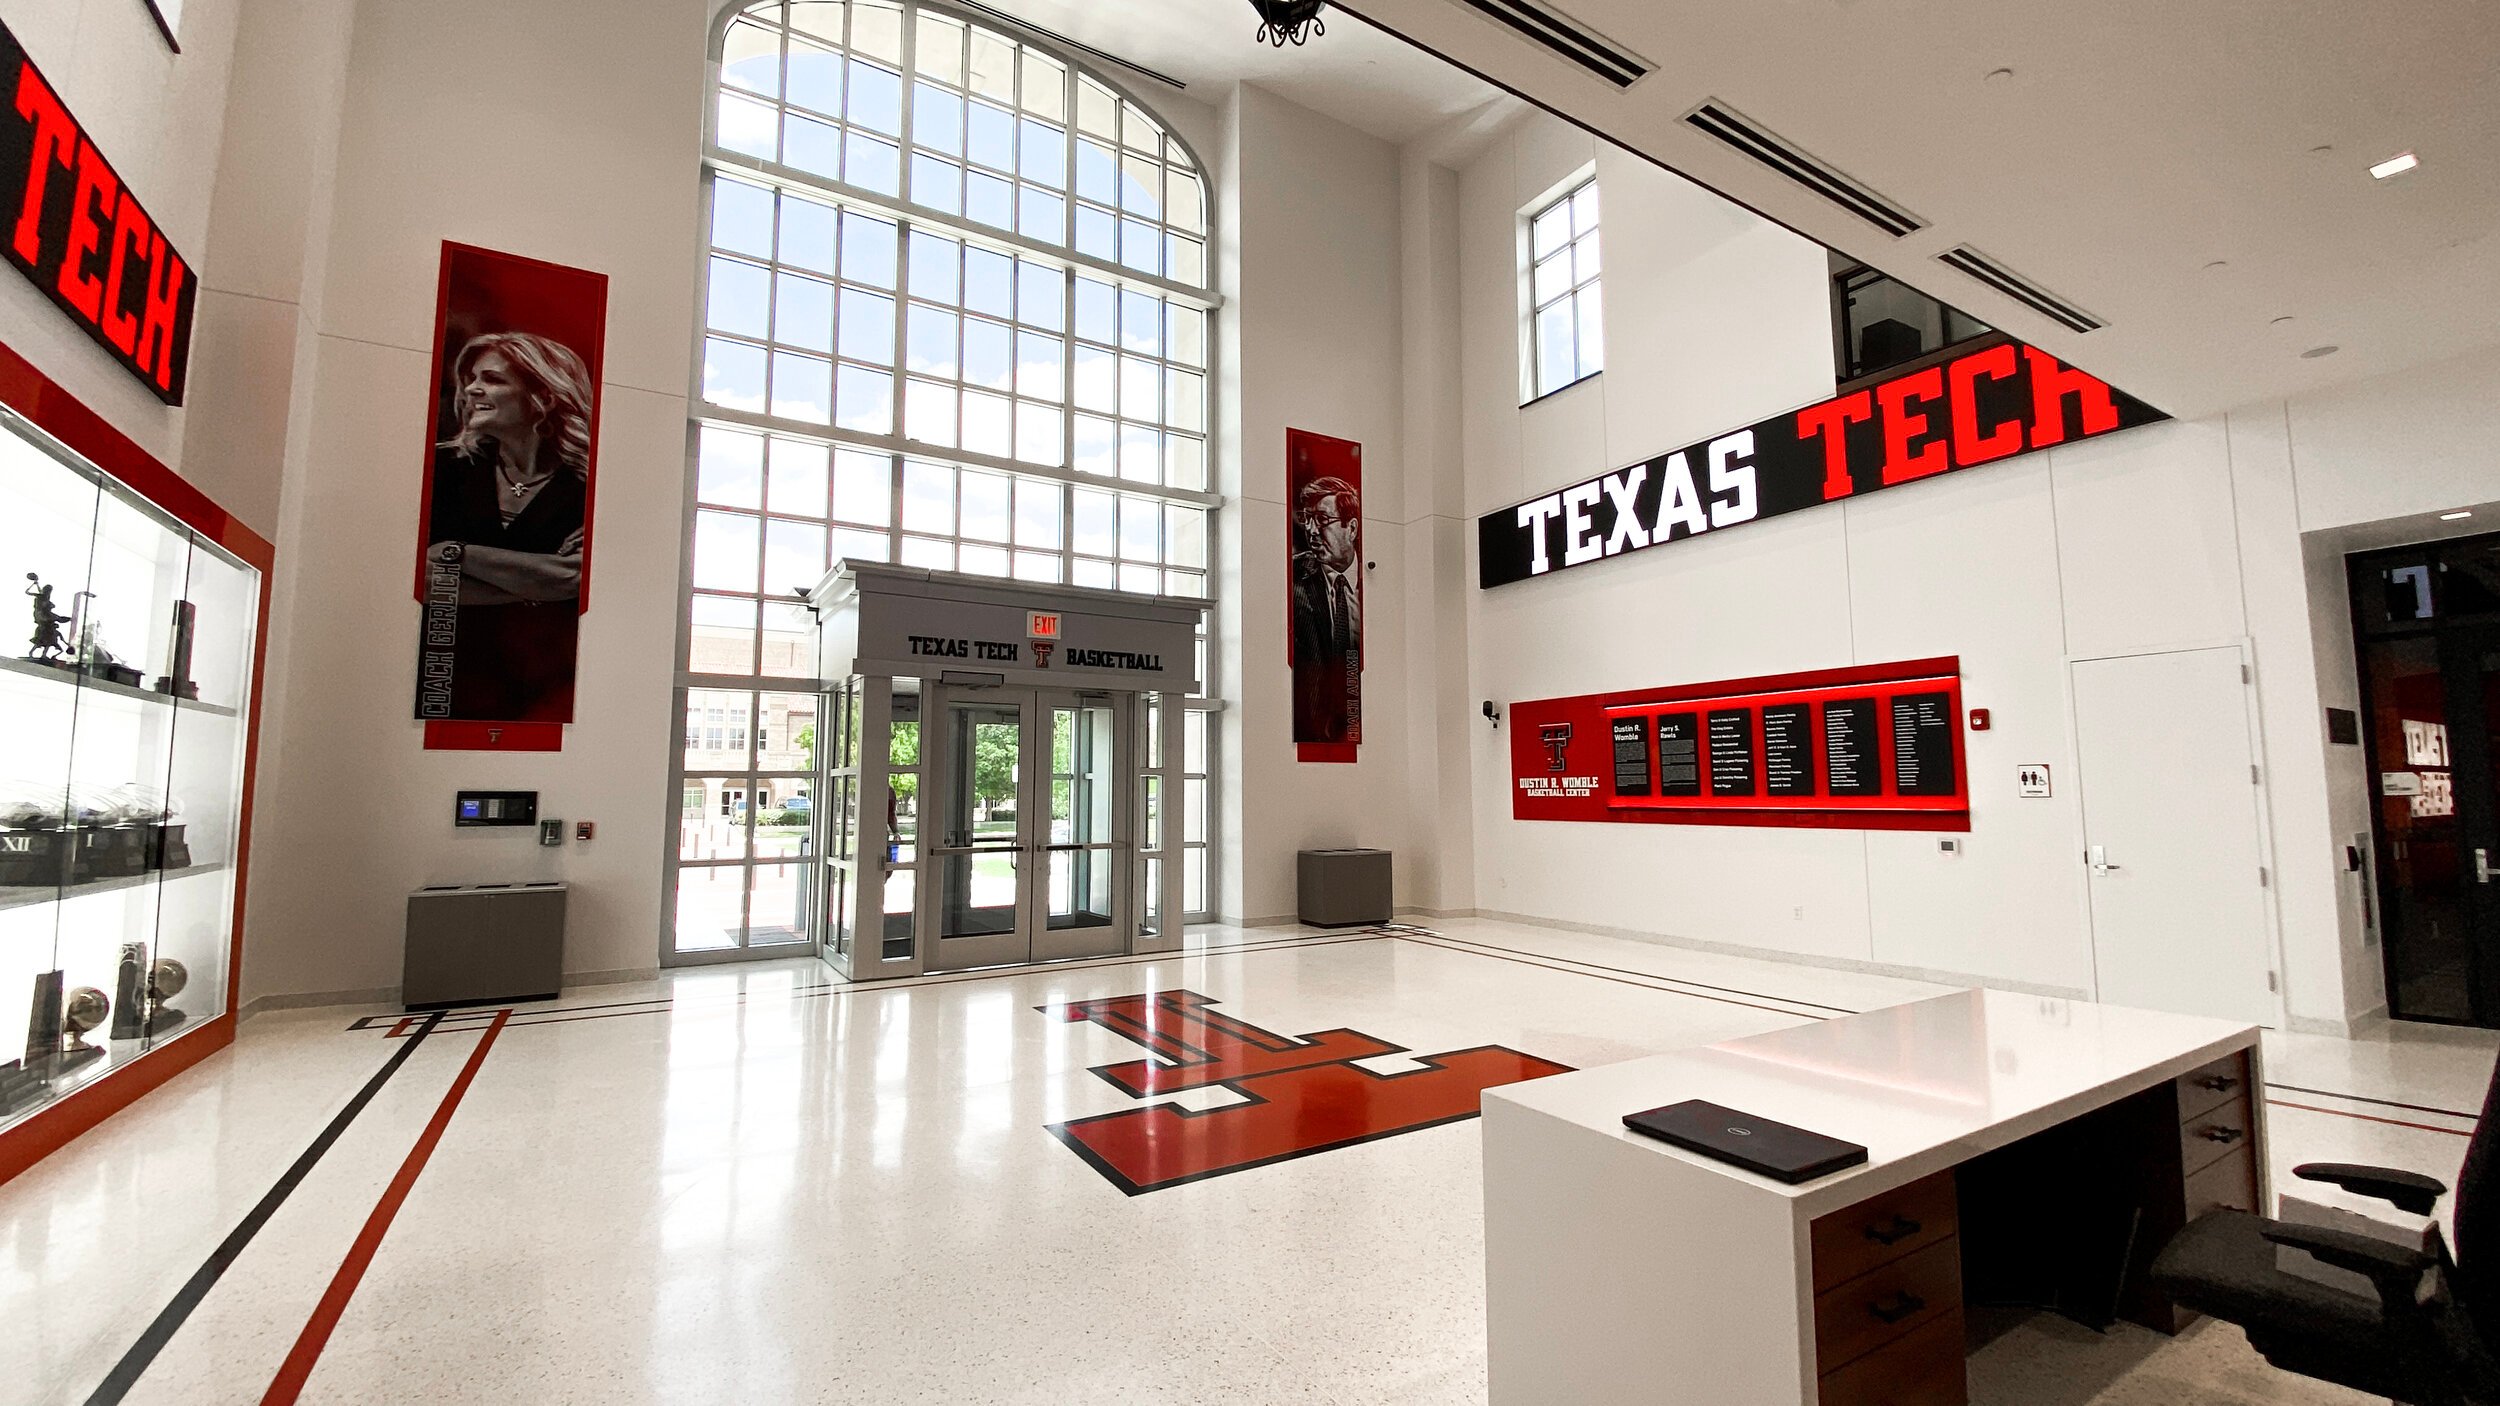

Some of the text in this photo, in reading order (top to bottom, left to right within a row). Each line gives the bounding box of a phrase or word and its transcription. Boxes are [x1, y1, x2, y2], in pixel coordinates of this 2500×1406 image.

[12, 58, 185, 392] TECH
[1517, 343, 2119, 575] TEXAS TECH
[1033, 615, 1058, 636] EXIT
[422, 563, 461, 718] COACH GERLICH
[908, 635, 1019, 661] TEXAS TECH
[1066, 648, 1164, 671] BASKETBALL
[1346, 649, 1361, 742] COACH ADAMS
[1613, 725, 1634, 733] Dustin
[1614, 733, 1639, 741] Womble
[1519, 776, 1599, 789] DUSTIN R. WOMBLE
[1527, 788, 1591, 797] BASKETBALL CENTER
[2, 836, 32, 852] XII
